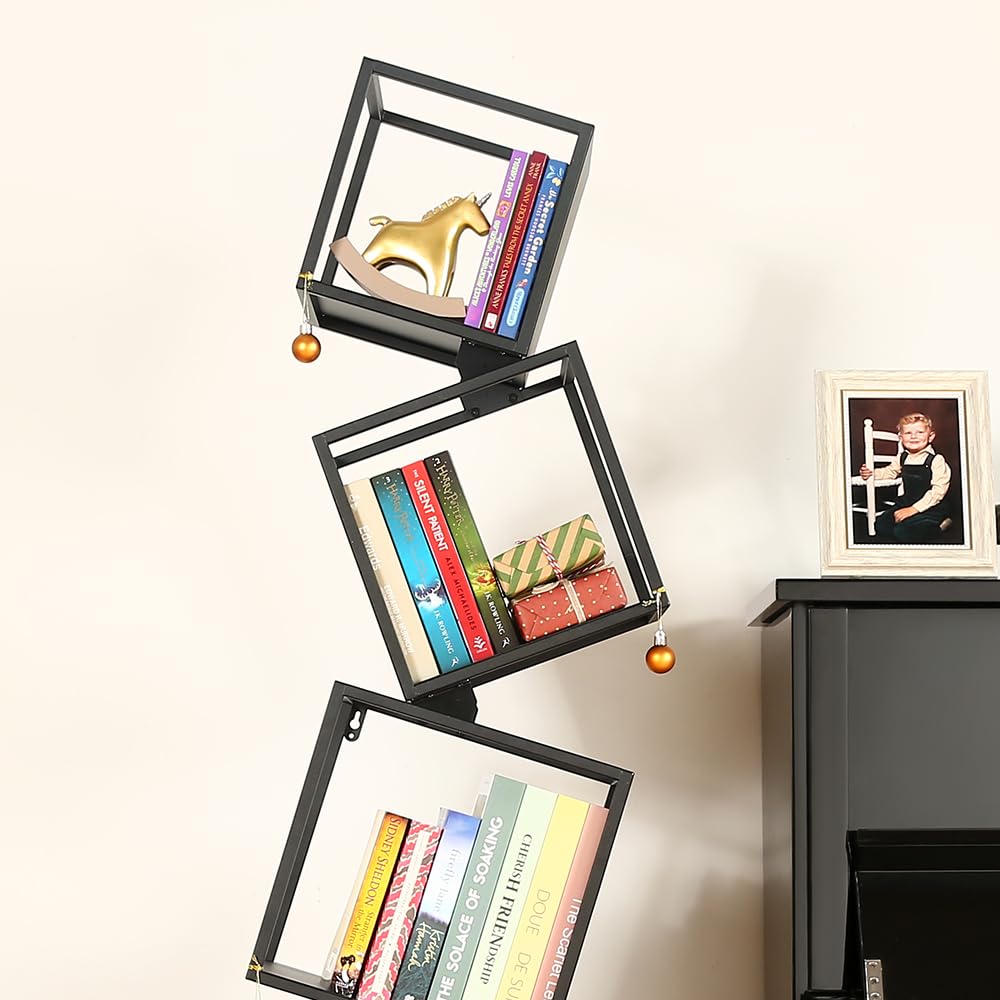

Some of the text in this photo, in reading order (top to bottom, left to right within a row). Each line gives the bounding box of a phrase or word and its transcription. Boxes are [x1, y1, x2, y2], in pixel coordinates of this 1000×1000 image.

[522, 182, 533, 203] ANNEX
[512, 224, 521, 236] THE
[515, 202, 527, 224] SECRET
[536, 200, 554, 234] Secret
[502, 252, 513, 269] TALES
[507, 235, 518, 253] FROM
[524, 237, 543, 275] Garden
[491, 290, 502, 309] ANNE
[436, 463, 453, 495] HARRY
[411, 468, 448, 551] THE SILENT PATIENT
[359, 525, 382, 570] Edwards
[444, 556, 456, 576] ALEX
[453, 579, 476, 630] MICHAELIDES
[488, 601, 504, 634] ROWLING
[437, 620, 453, 654] ROWLING
[379, 817, 400, 856] SIDNEY
[472, 814, 504, 885] SOAKING
[364, 856, 388, 906] SHELDON
[440, 848, 460, 883] firefly
[463, 887, 482, 911] OF
[478, 833, 532, 985] CHERISH FRIENDSHIP
[525, 889, 550, 935] DOUE
[565, 897, 582, 925] The
[346, 908, 364, 948] the Mirror
[356, 909, 373, 942] Stranger
[445, 914, 473, 972] SOLACE
[405, 921, 432, 972] Hannah
[421, 928, 444, 968] Kristin
[513, 951, 532, 974] DE
[548, 926, 573, 978] Scarlet
